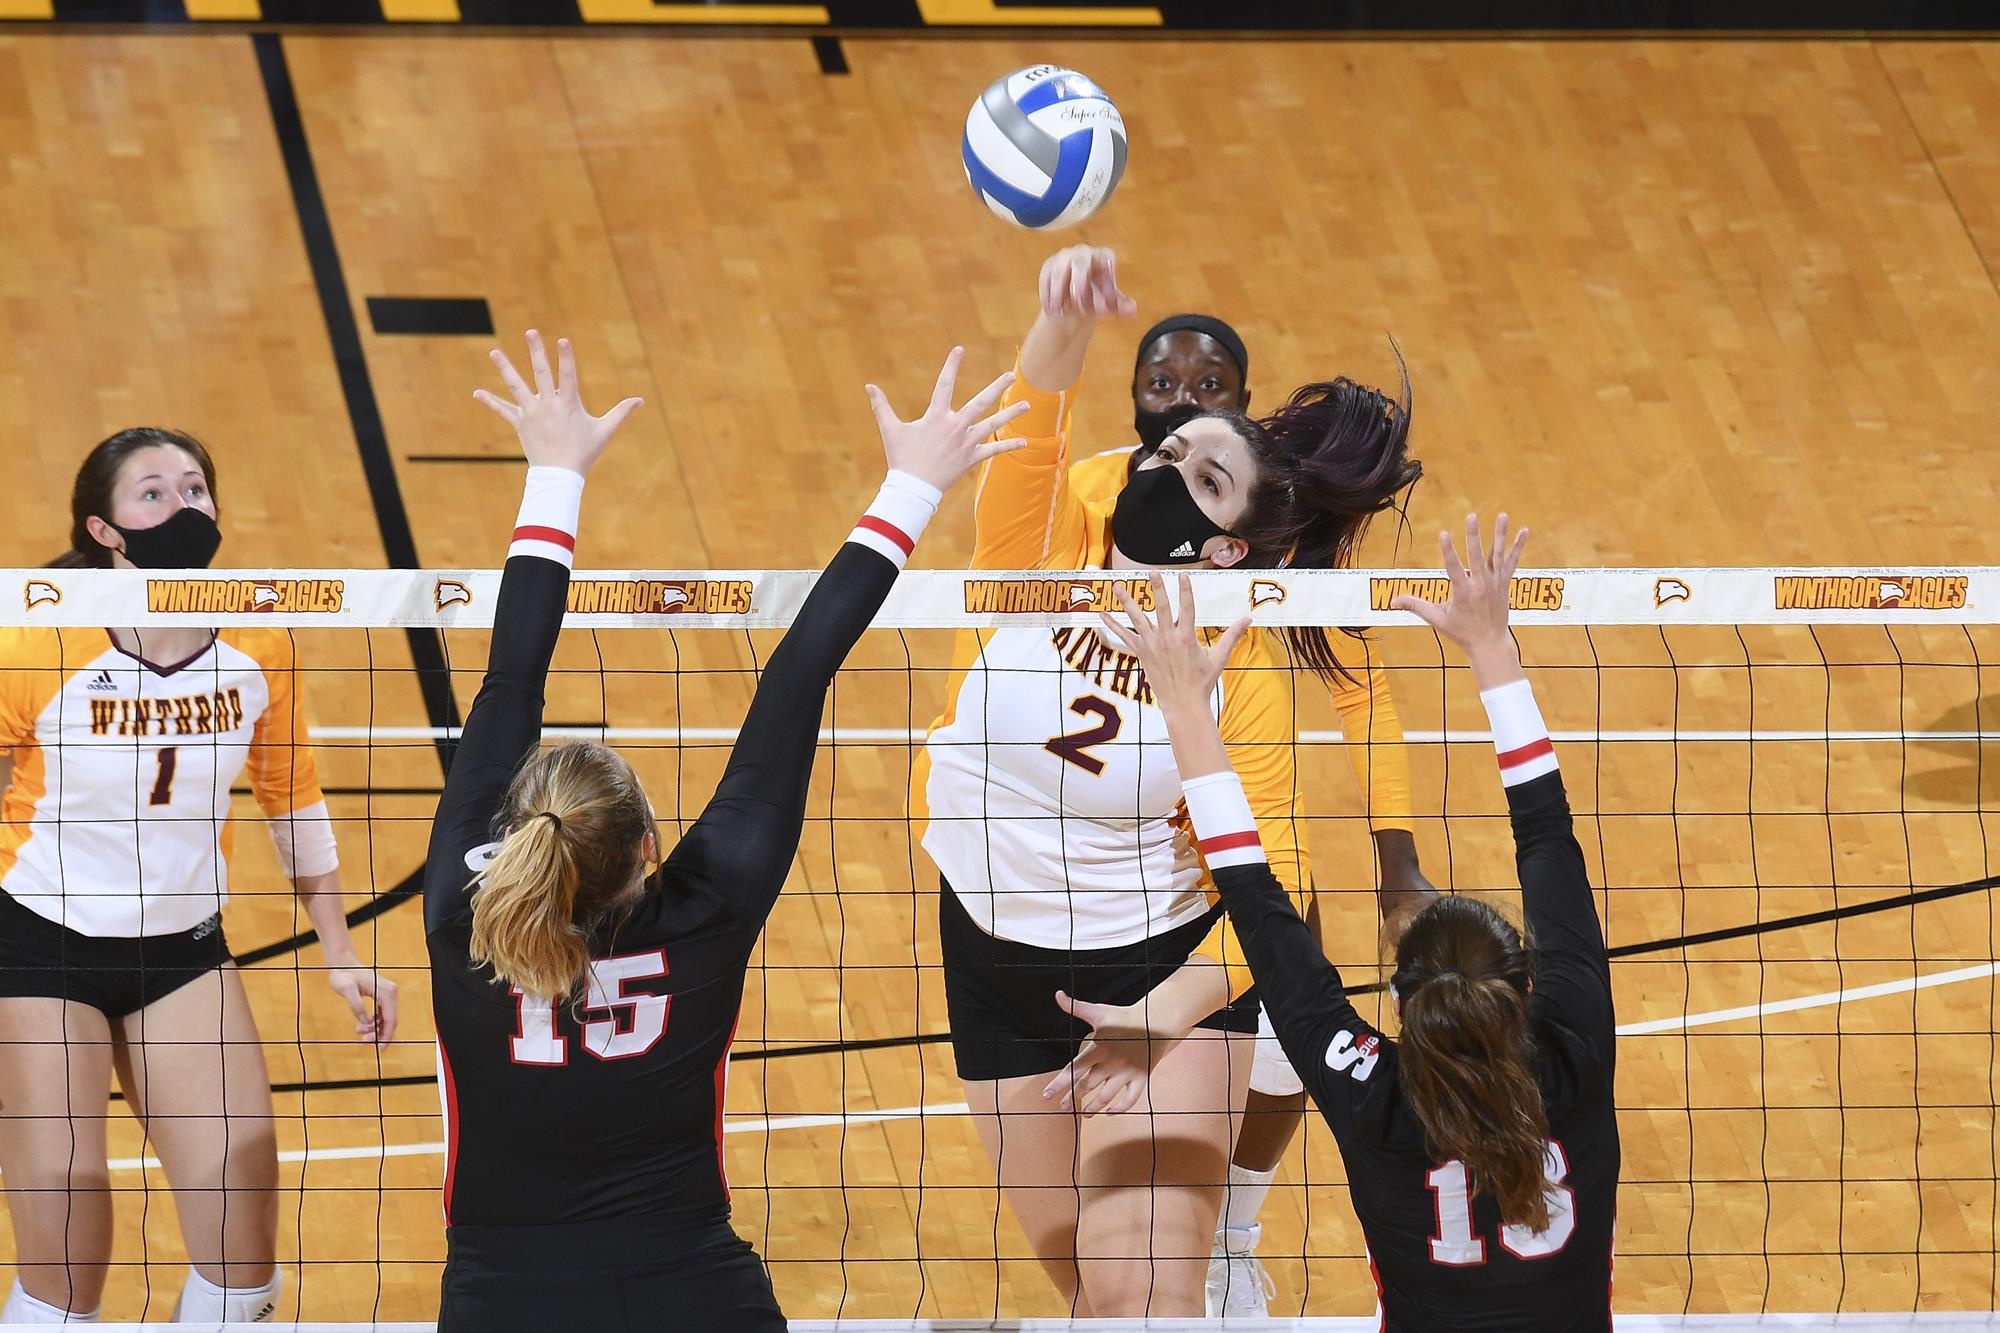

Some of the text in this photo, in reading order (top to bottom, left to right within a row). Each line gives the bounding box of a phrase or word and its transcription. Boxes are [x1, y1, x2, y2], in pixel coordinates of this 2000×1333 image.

[1169, 550, 1196, 558] adidas
[147, 580, 256, 613] WINTHROP
[272, 580, 345, 613] EAGLES
[682, 581, 753, 614] EAGLES
[964, 580, 1071, 613] WINTHROP
[1370, 578, 1452, 610] WINTHR
[1508, 578, 1565, 611] AGLES
[1774, 577, 1880, 609] WINTHROP
[1897, 577, 1969, 609] EAGLES
[86, 683, 118, 691] adidas
[89, 687, 244, 737] WINTHROP
[1044, 693, 1123, 778] 2
[148, 746, 178, 806] 1
[508, 947, 673, 1067] 15
[1426, 1139, 1576, 1266] 13
